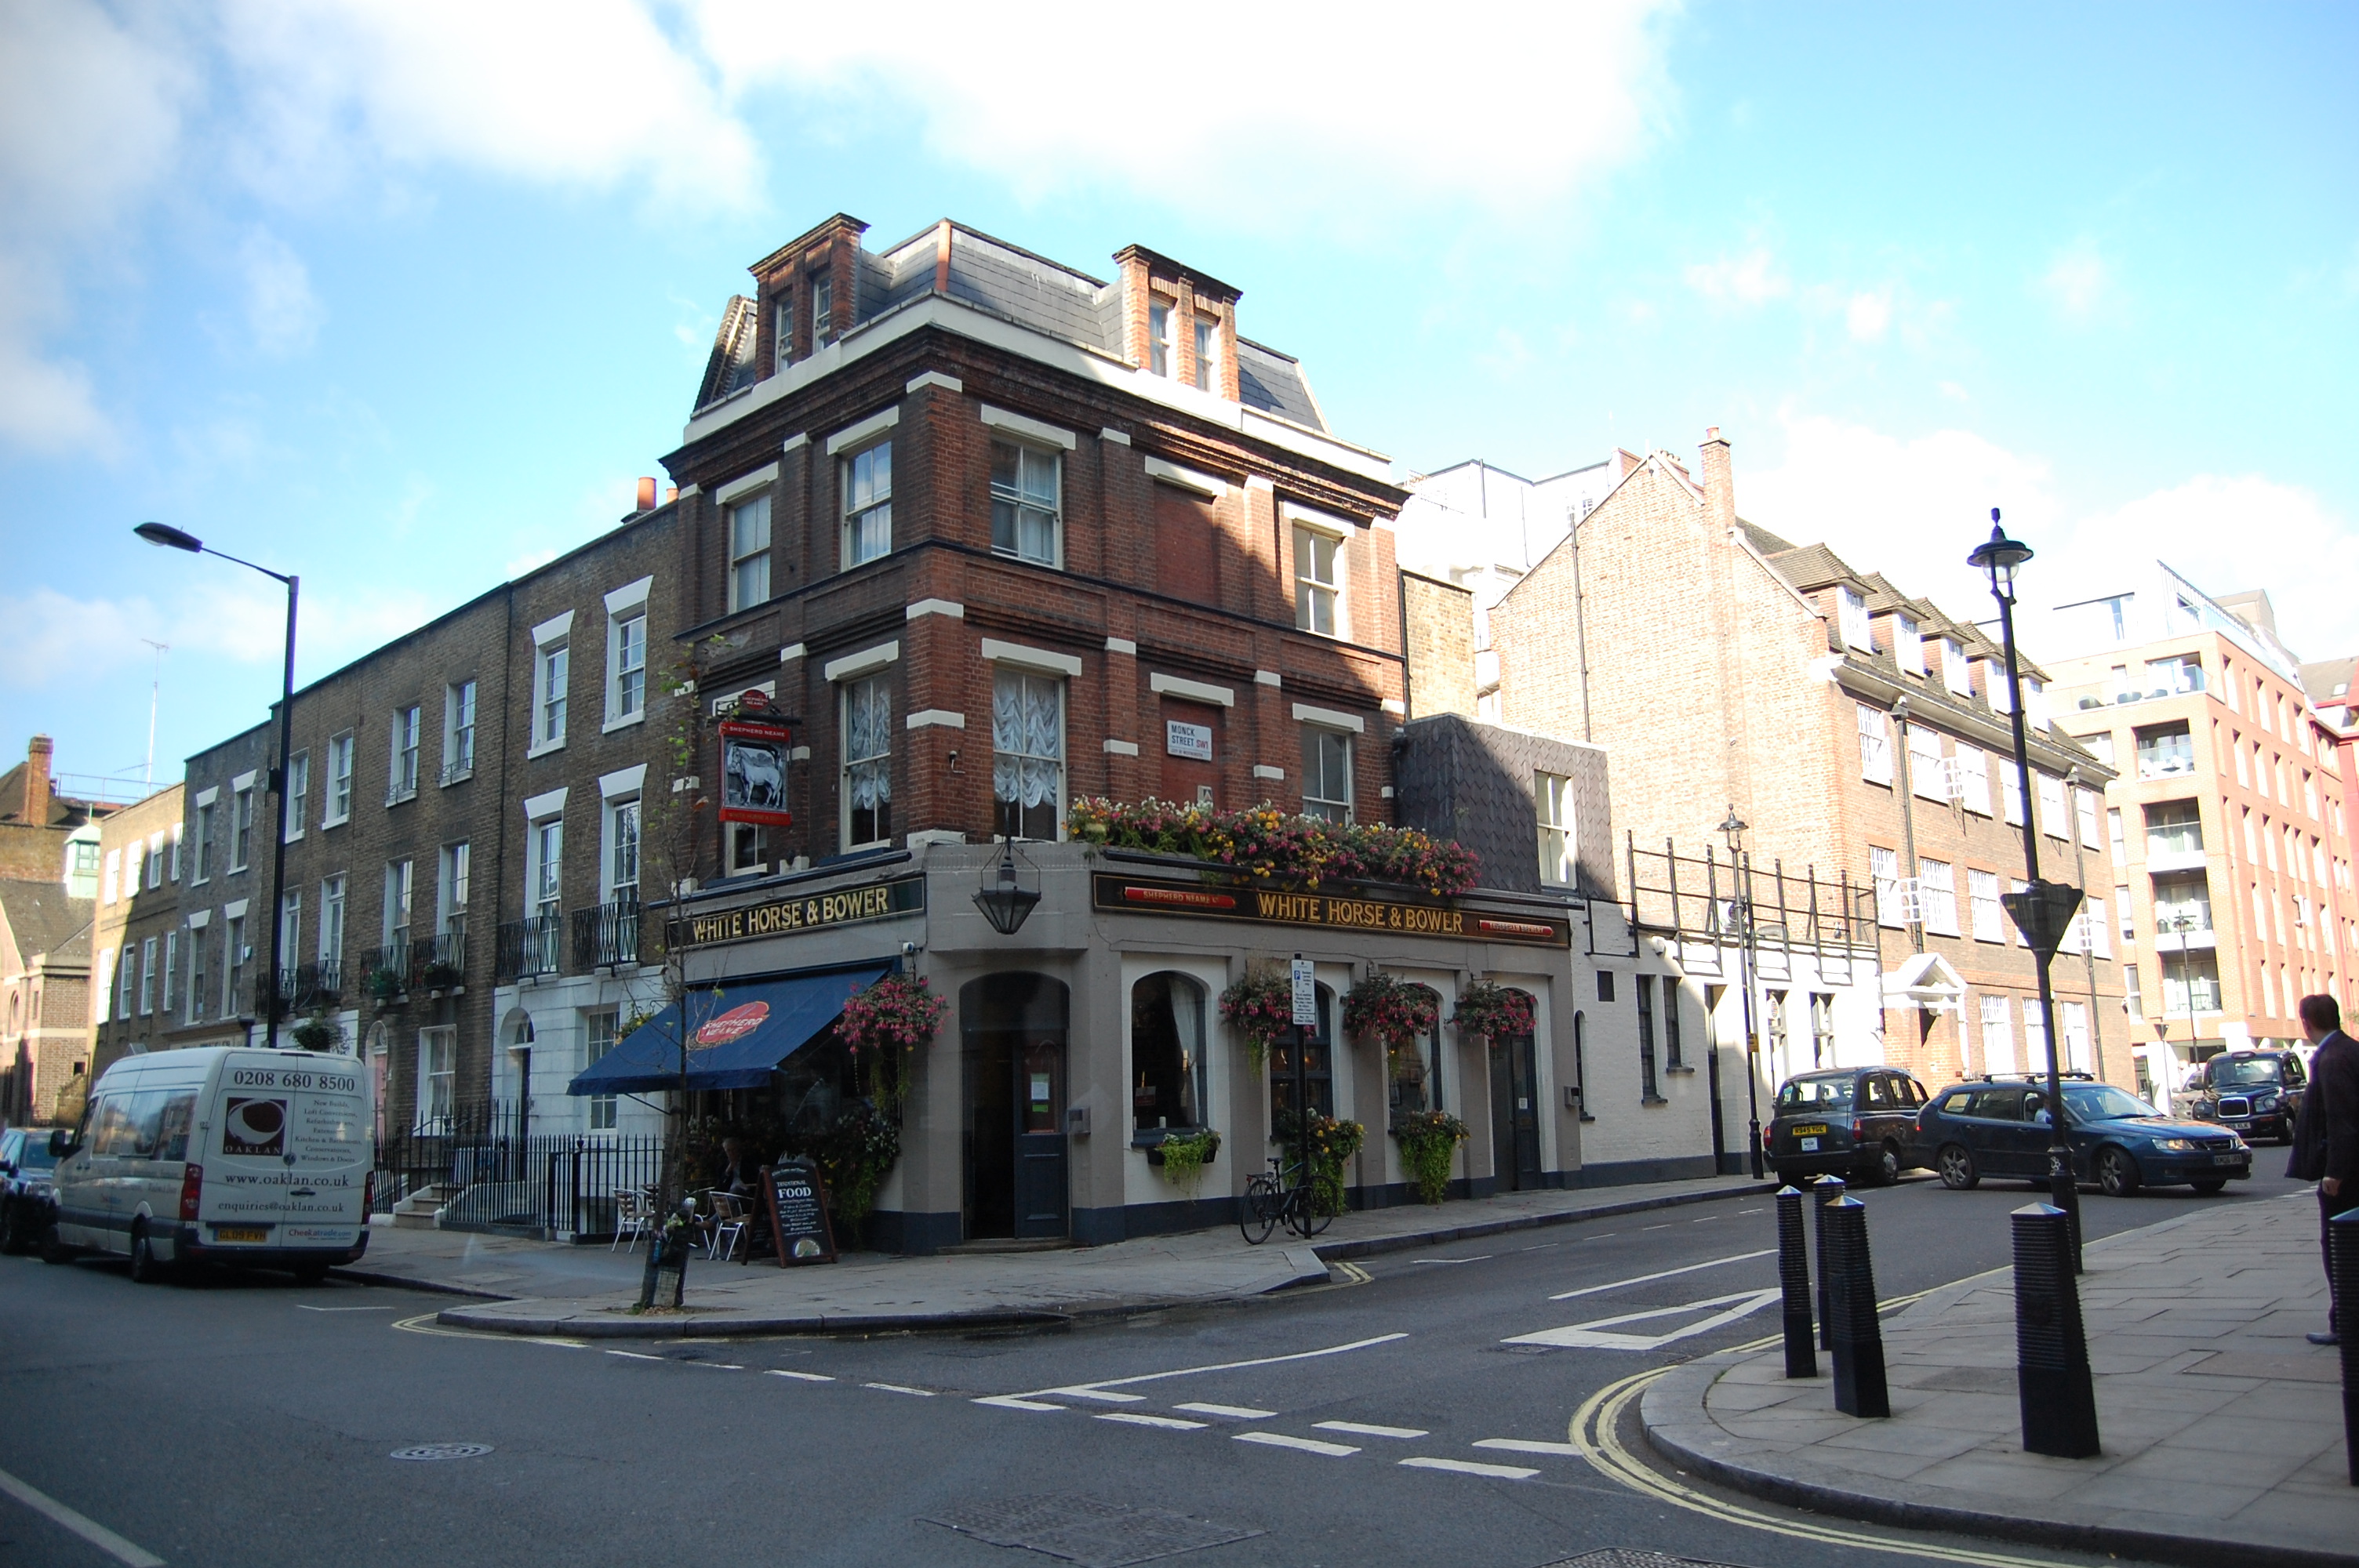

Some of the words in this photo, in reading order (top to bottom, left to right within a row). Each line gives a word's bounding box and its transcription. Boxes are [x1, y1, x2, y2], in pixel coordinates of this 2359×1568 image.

[729, 726, 763, 735] SHEPHERD
[1172, 724, 1195, 737] MONCK
[1172, 735, 1194, 746] STREET
[1196, 739, 1209, 750] SW1
[1143, 891, 1183, 902] SHEPHERD
[1186, 895, 1210, 903] NEAME
[693, 912, 743, 942] WHITE
[748, 902, 801, 935] HORSE
[807, 900, 818, 924] &
[823, 887, 889, 922] BOWER
[1257, 892, 1321, 923] WHITE
[1328, 899, 1386, 927] HORSE
[1389, 906, 1401, 928] &
[1405, 908, 1463, 935] BOWER
[703, 1018, 763, 1030] SHEPHERD
[234, 1070, 274, 1086] 0208
[282, 1073, 311, 1088] 680
[319, 1076, 354, 1091] 8500
[225, 1173, 350, 1186] www.oaklan.co.uk
[778, 1187, 812, 1199] FOOD
[218, 1200, 344, 1214] enquiries@oaklan.co.uk
